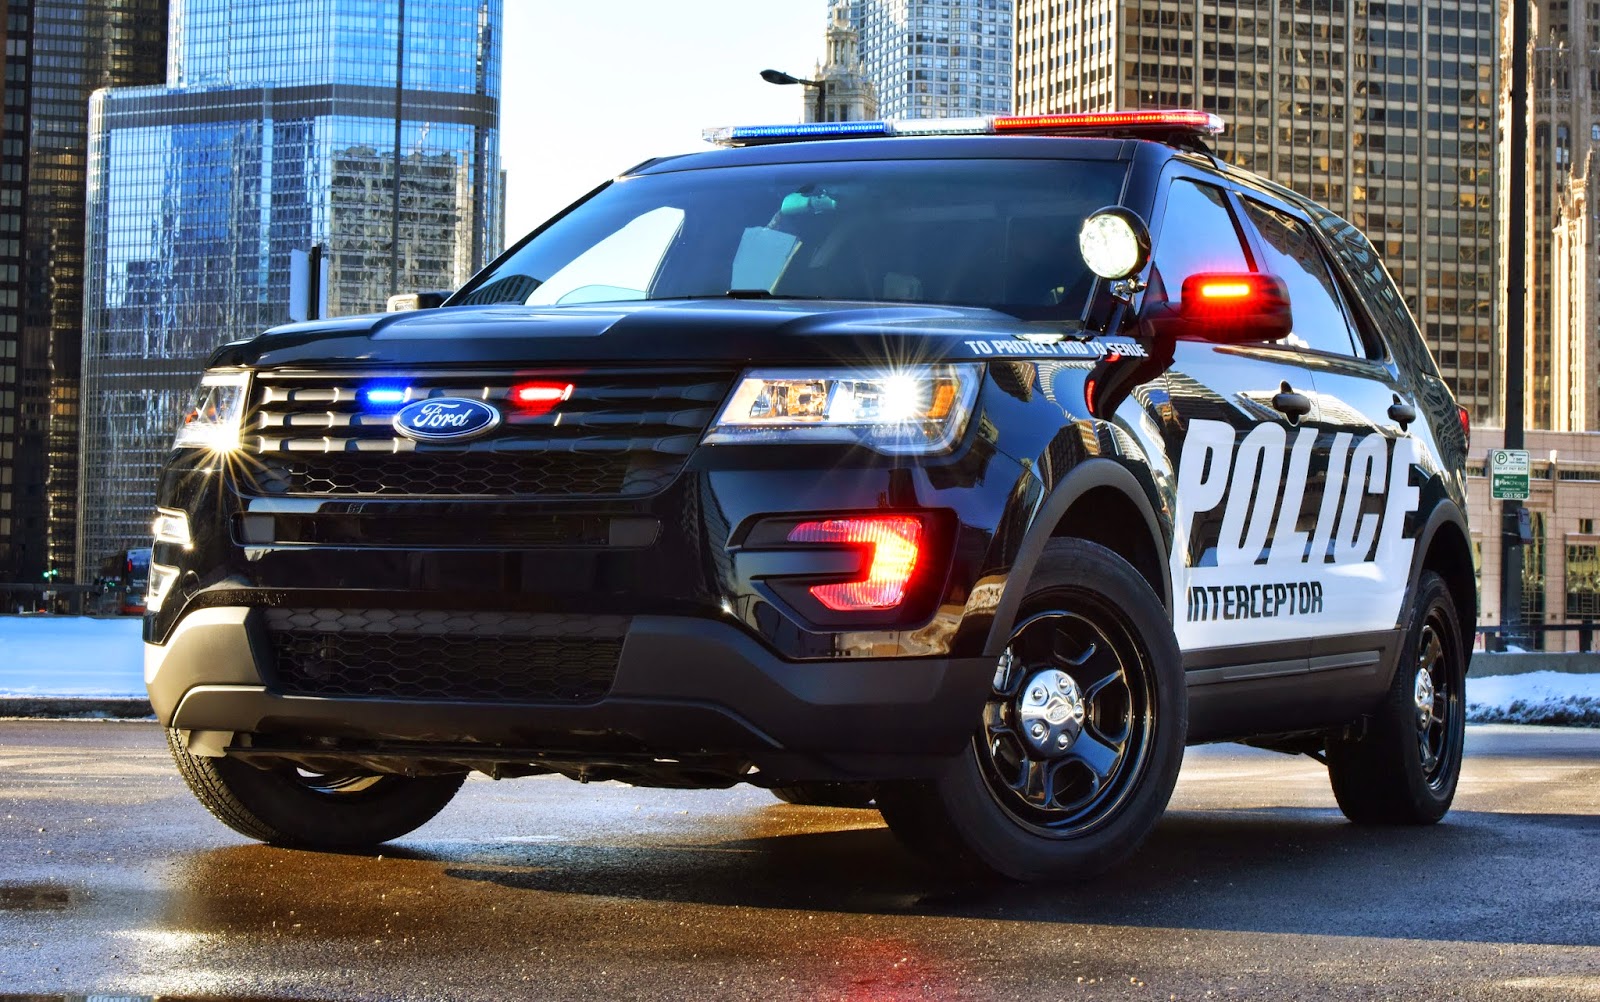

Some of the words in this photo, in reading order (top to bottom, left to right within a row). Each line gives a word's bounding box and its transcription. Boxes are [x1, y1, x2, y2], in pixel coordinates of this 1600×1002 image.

[964, 340, 993, 355] TO
[991, 339, 1059, 355] PROTECT
[1061, 340, 1089, 355] AND
[1089, 341, 1108, 356] TO
[413, 403, 473, 427] Ford
[1172, 418, 1421, 569] POLICE
[1186, 580, 1323, 622] INTERCEPTOR
